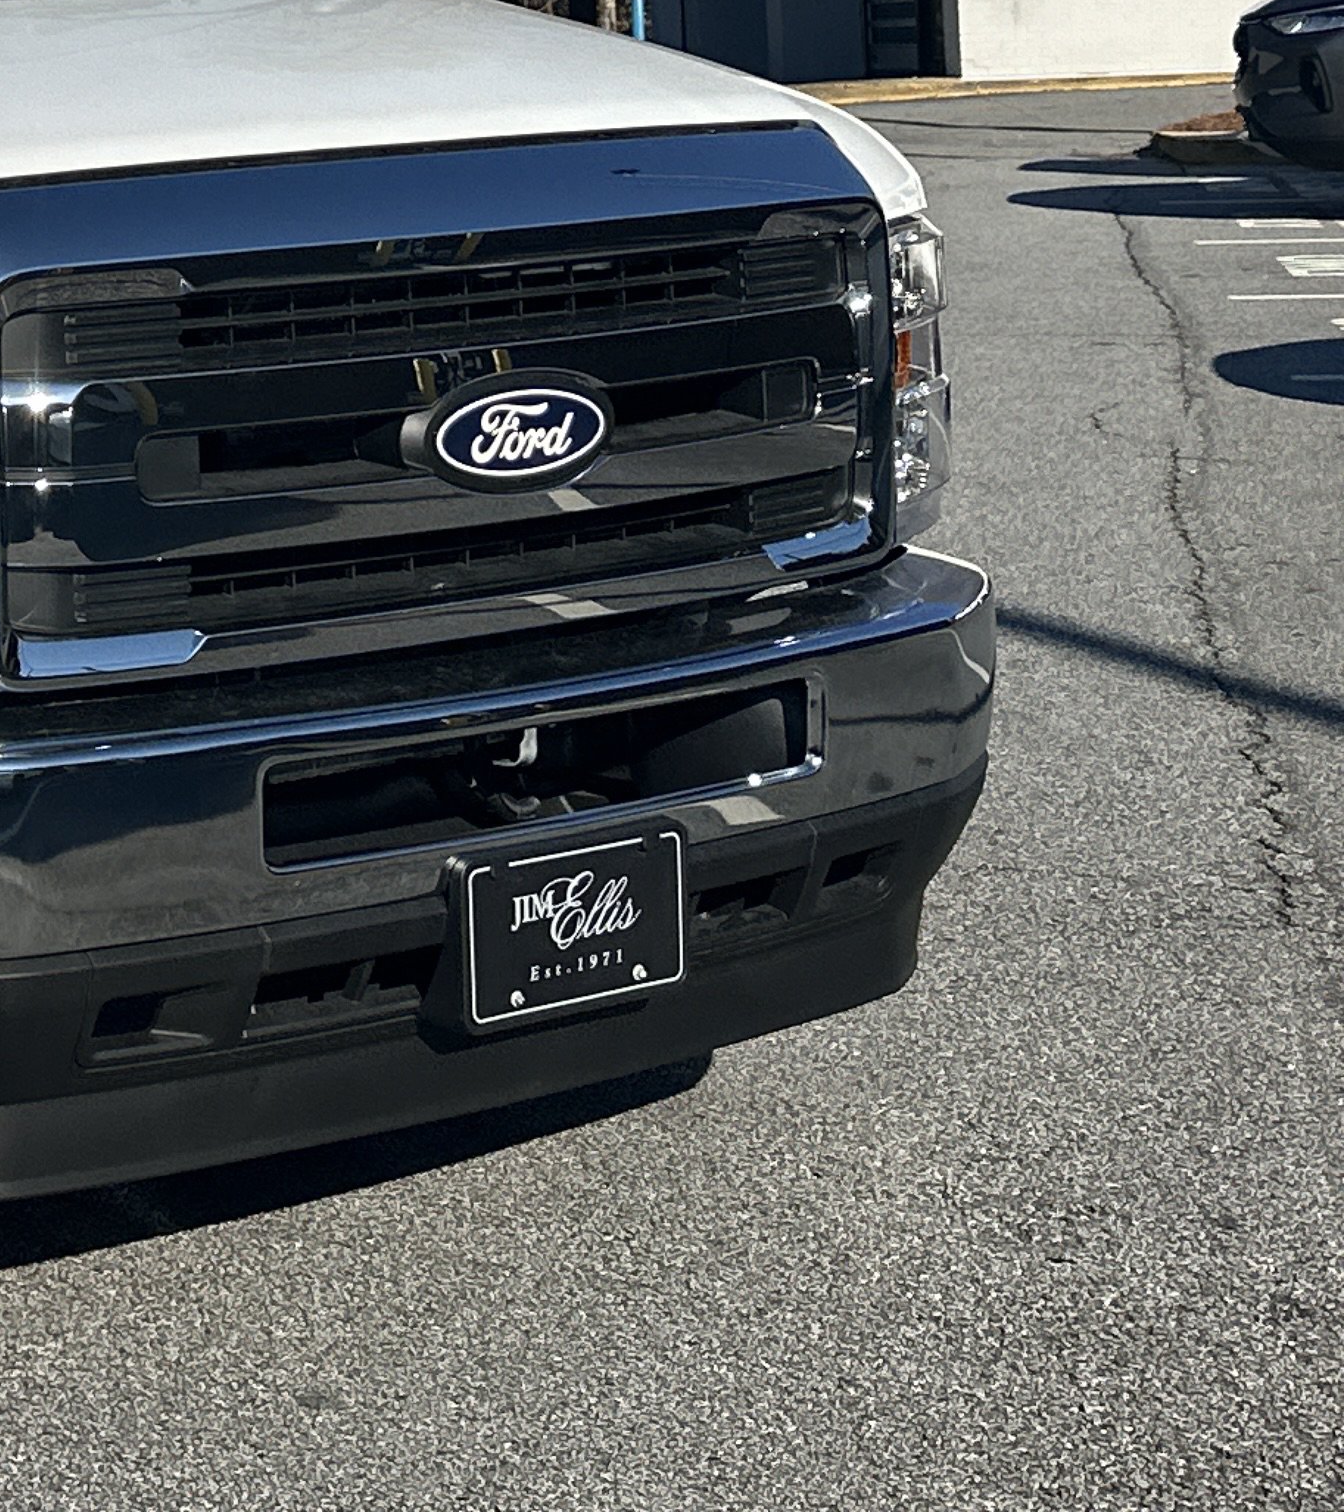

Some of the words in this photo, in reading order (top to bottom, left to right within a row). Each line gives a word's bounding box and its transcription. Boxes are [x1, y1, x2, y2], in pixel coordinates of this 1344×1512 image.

[470, 401, 575, 465] Ford
[510, 889, 556, 933] JIM
[540, 870, 643, 950] Ellis
